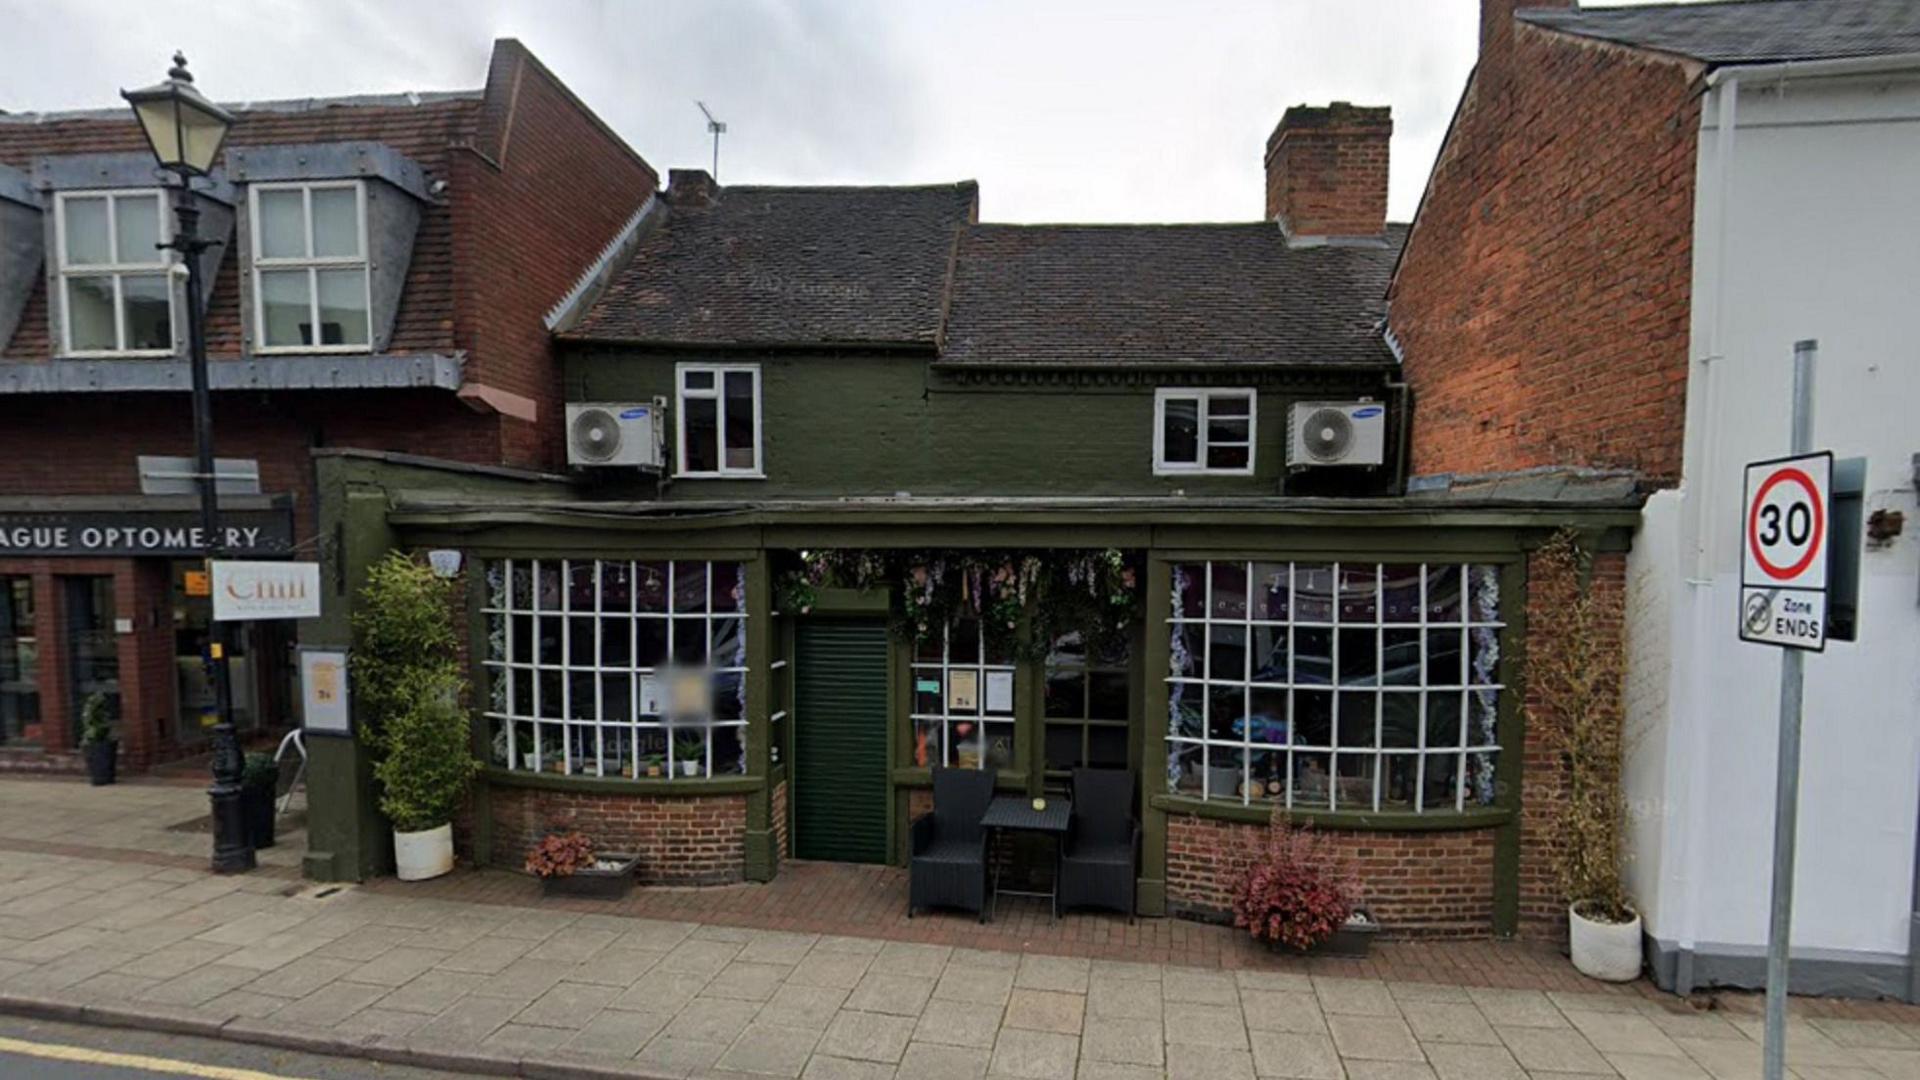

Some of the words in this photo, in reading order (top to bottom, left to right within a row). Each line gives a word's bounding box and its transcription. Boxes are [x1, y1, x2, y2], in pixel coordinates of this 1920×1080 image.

[1760, 502, 1810, 546] 30
[80, 527, 260, 548] OPTOMERY
[1783, 598, 1812, 615] Zone
[1776, 617, 1819, 639] ENDS
